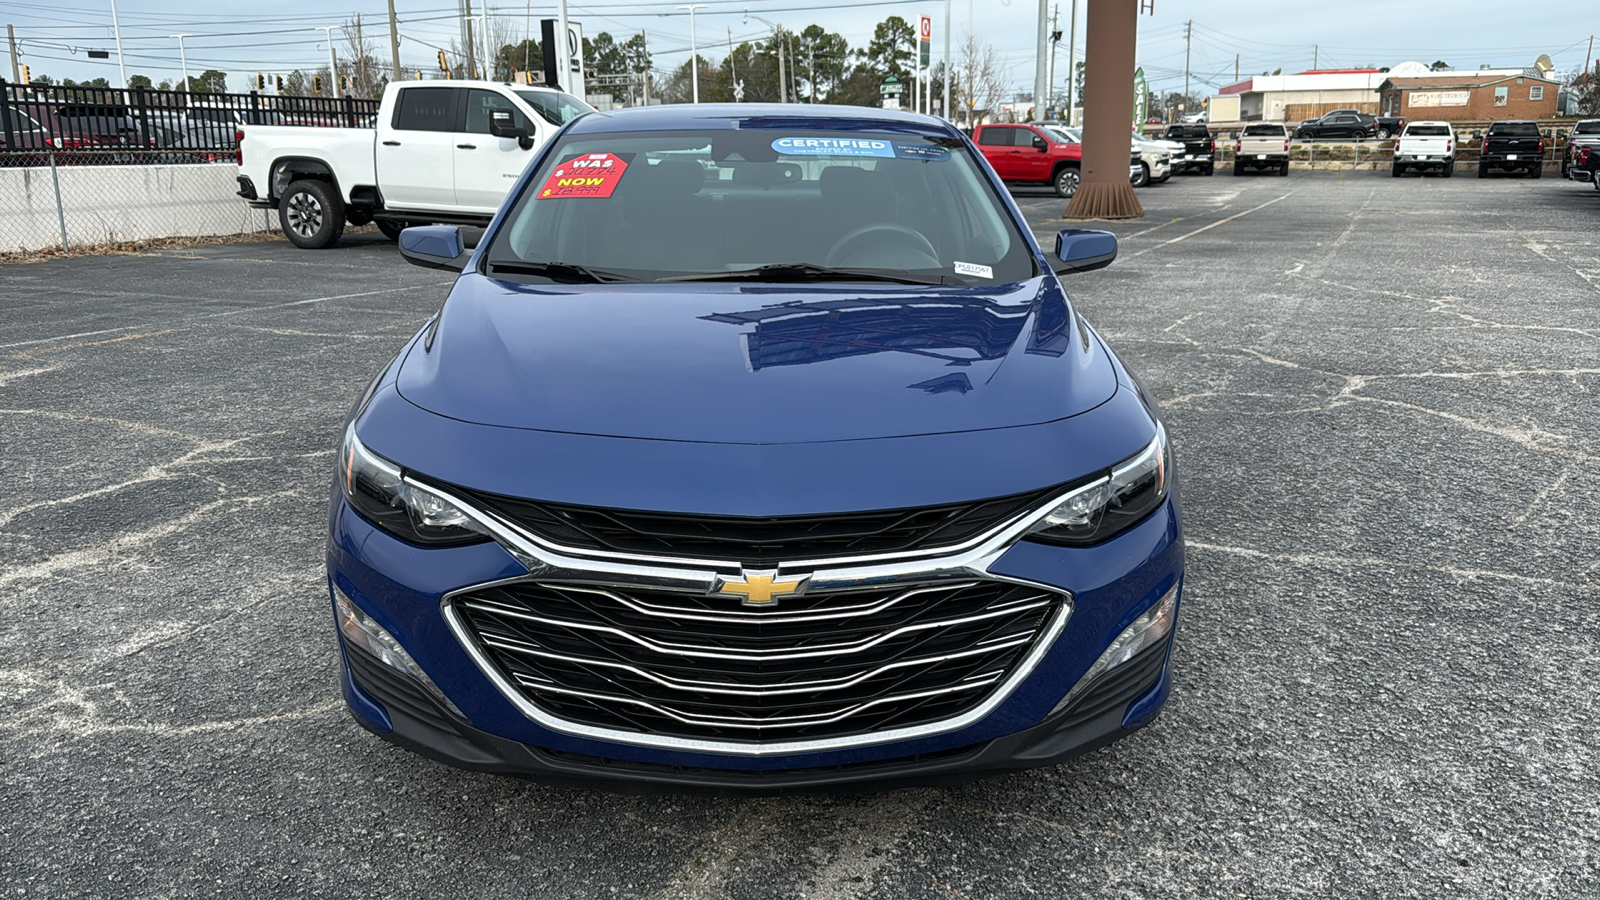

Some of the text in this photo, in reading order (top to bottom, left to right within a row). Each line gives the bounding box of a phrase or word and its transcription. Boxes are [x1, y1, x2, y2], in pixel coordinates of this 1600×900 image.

[1136, 83, 1144, 125] SALE
[777, 139, 885, 149] CERTIFIED
[573, 160, 613, 168] WAS
[557, 178, 604, 186] NOW
